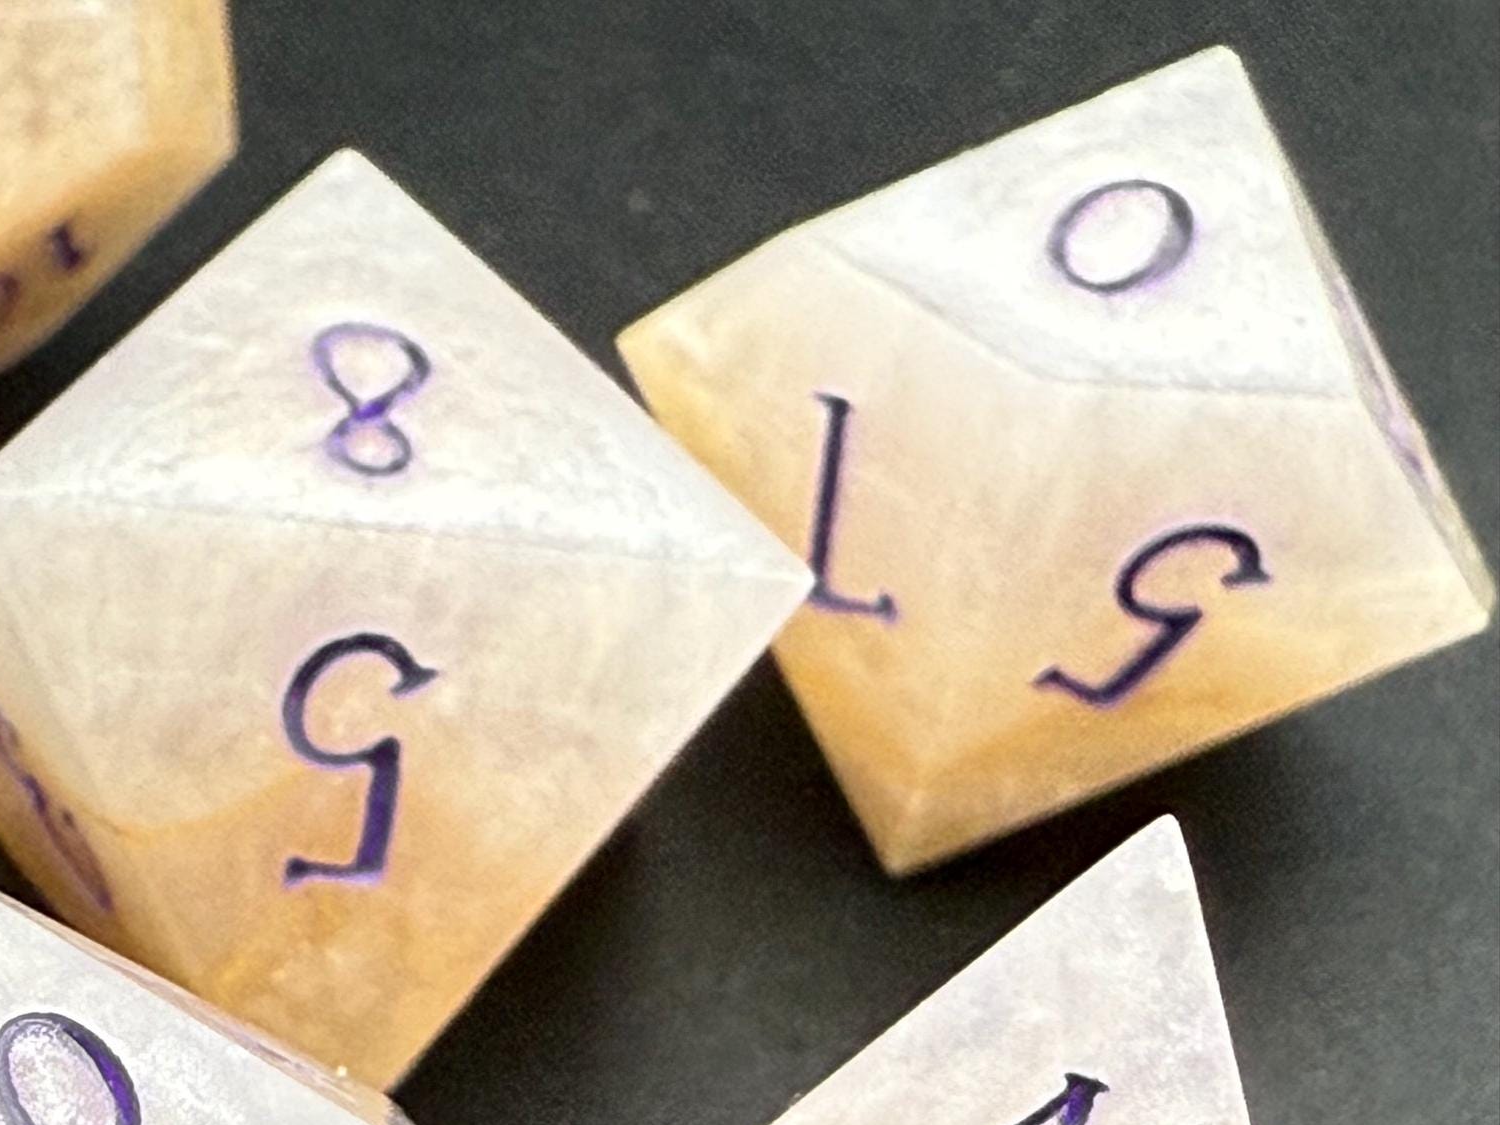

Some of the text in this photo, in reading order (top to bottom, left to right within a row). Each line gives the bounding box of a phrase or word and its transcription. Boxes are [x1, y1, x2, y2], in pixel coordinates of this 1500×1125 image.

[1048, 178, 1194, 297] 0
[312, 321, 432, 476] 8
[1030, 522, 1272, 708] 5
[282, 632, 439, 888] 5
